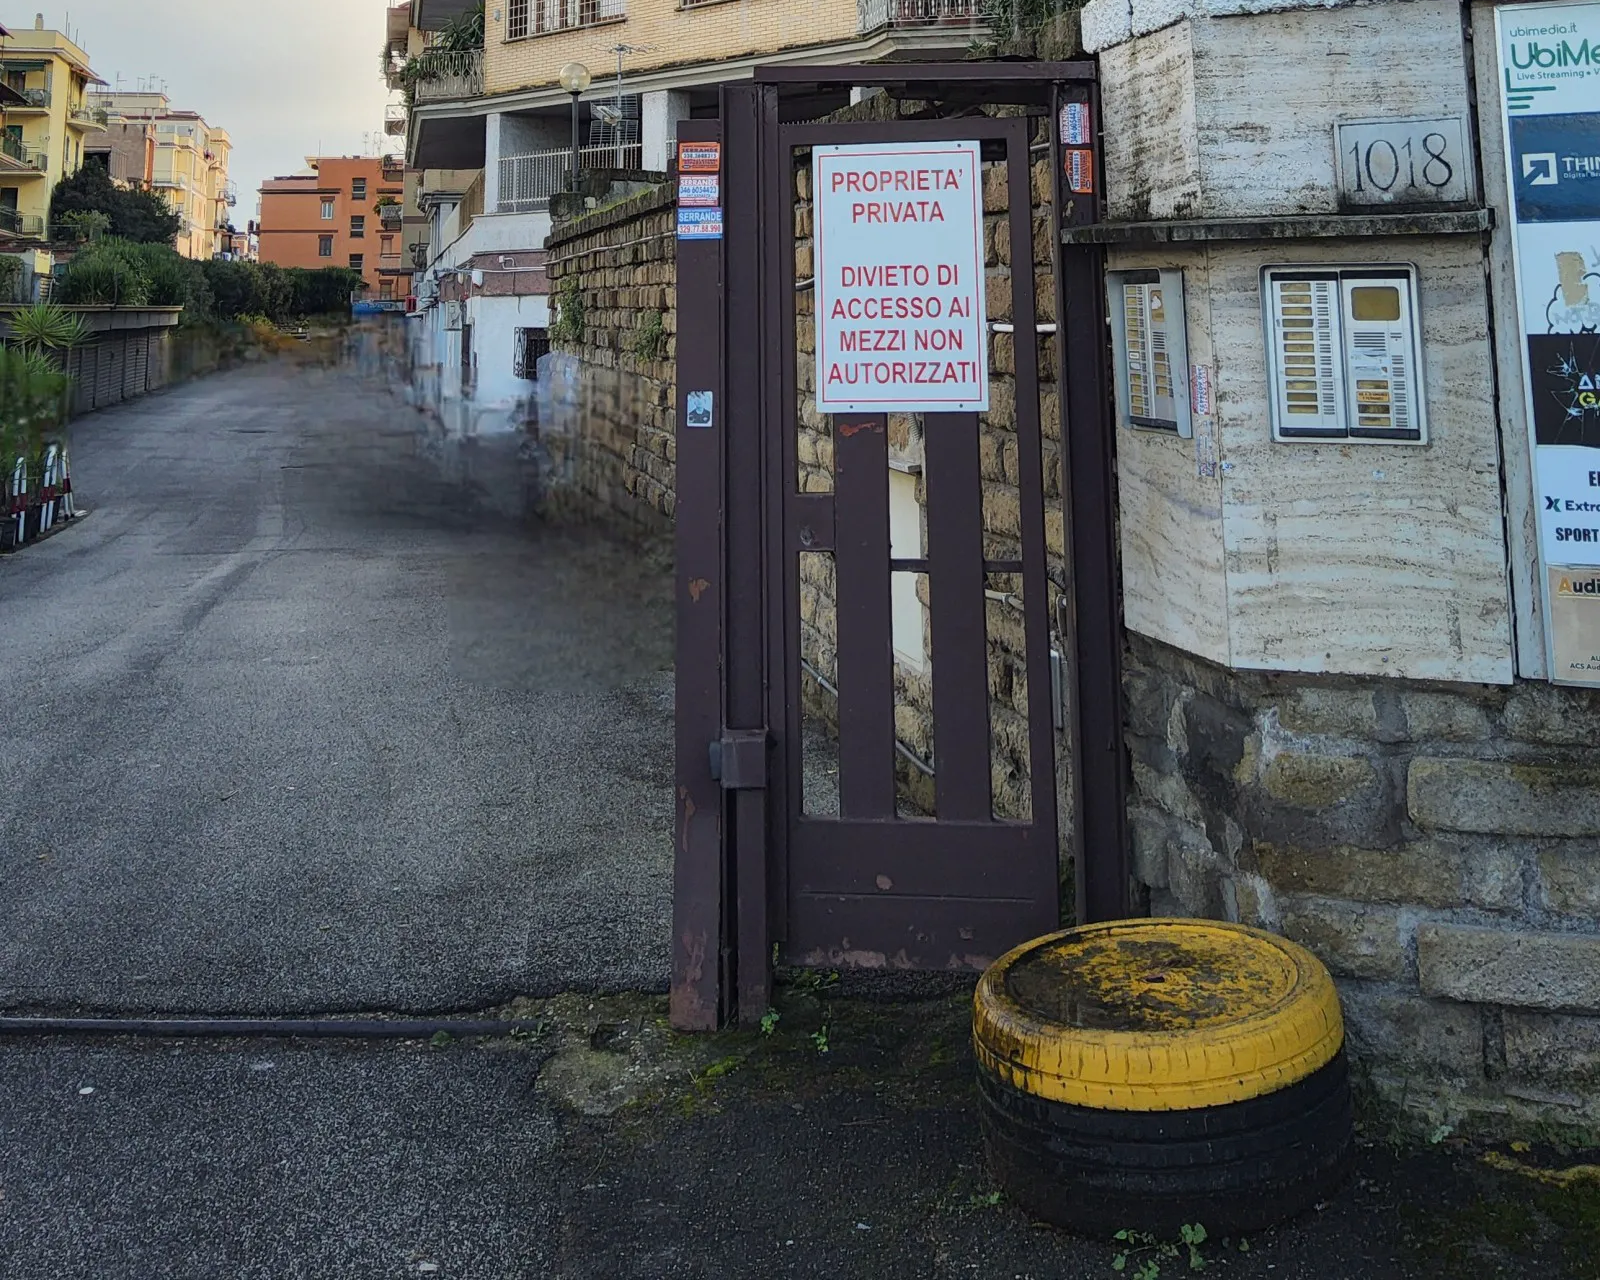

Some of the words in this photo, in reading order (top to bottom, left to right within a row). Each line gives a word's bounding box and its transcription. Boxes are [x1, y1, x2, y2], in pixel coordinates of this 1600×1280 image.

[1509, 22, 1577, 37] ubimedia.it
[1517, 72, 1535, 80] Live
[1537, 70, 1584, 79] Streaming
[1348, 132, 1453, 192] 1018
[832, 169, 963, 193] PROPRIETA'
[679, 211, 722, 221] SERRANDE
[852, 201, 945, 223] PRIVATA
[841, 265, 929, 287] DIVIETO
[937, 264, 958, 286] DI
[831, 297, 942, 319] ACCESSO
[948, 296, 970, 318] AI
[840, 330, 906, 351] MEZZI
[914, 329, 963, 351] NON
[828, 361, 977, 384] AUTORIZZATI
[1556, 527, 1599, 542] SPORT
